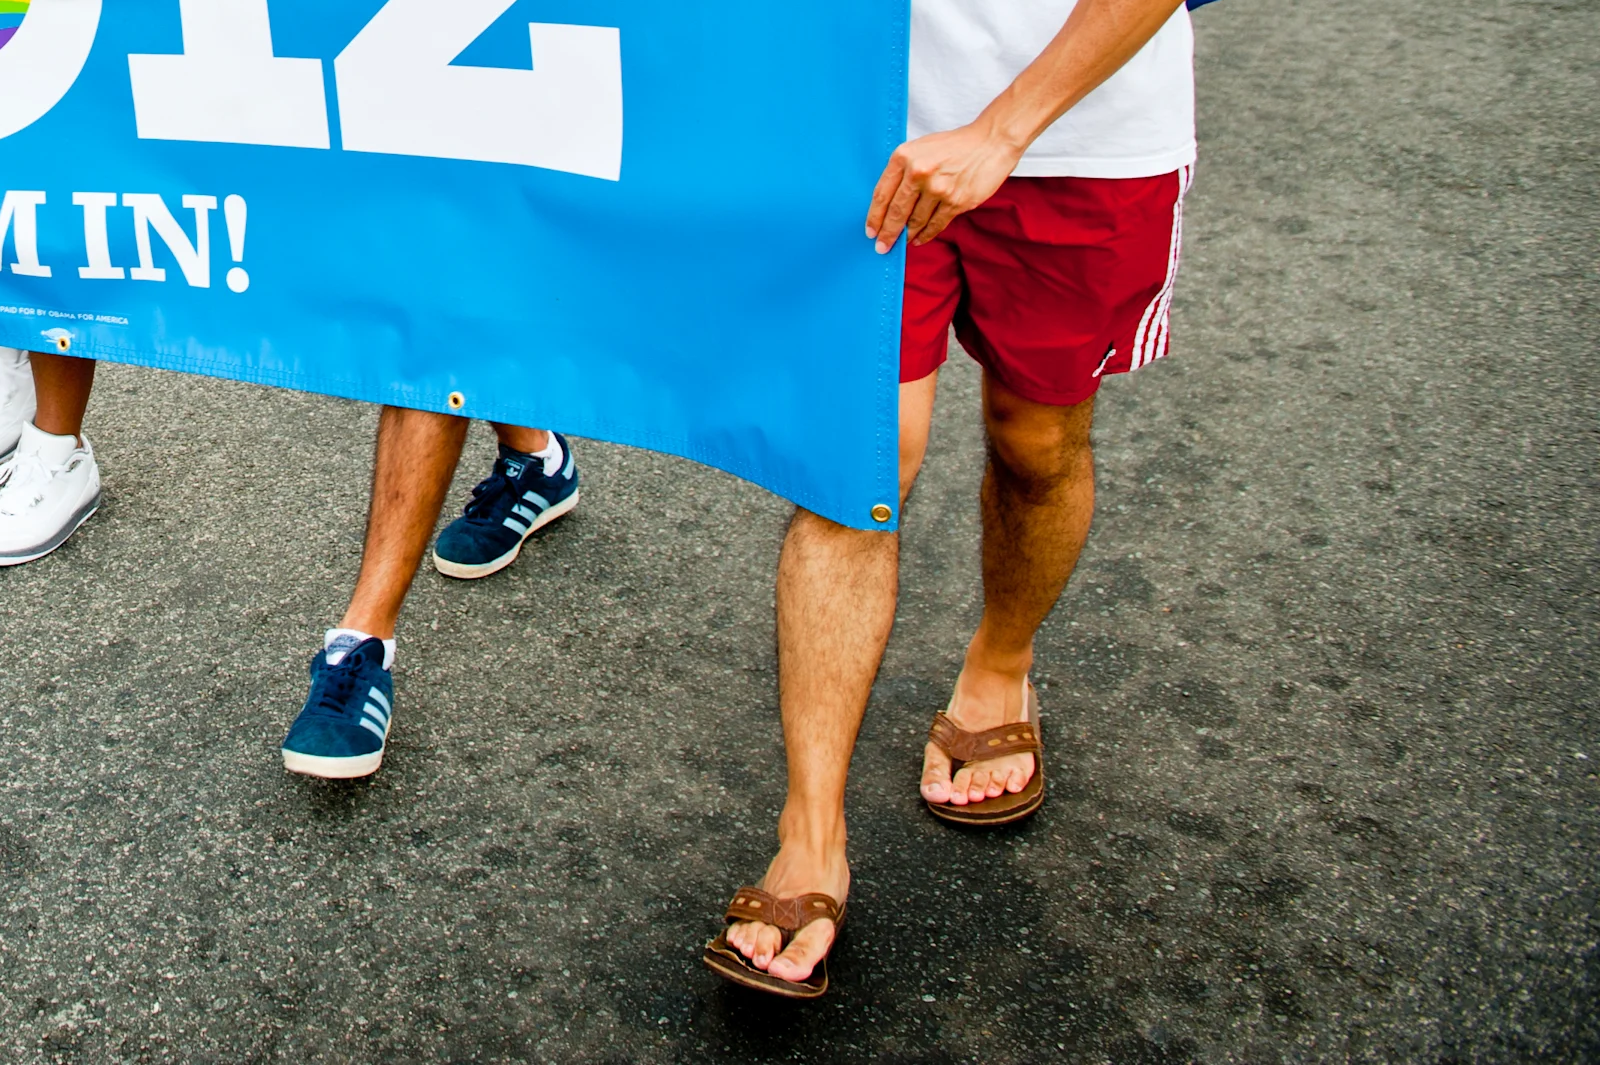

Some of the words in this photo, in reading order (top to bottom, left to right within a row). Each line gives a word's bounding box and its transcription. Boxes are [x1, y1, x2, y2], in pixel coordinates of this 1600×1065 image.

[72, 191, 250, 294] IN!
[0, 305, 18, 315] PAID
[18, 307, 35, 316] FOR
[36, 308, 47, 317] BY
[48, 310, 76, 320] OBAMA
[77, 313, 94, 321] FOR
[95, 314, 129, 325] AMERICA
